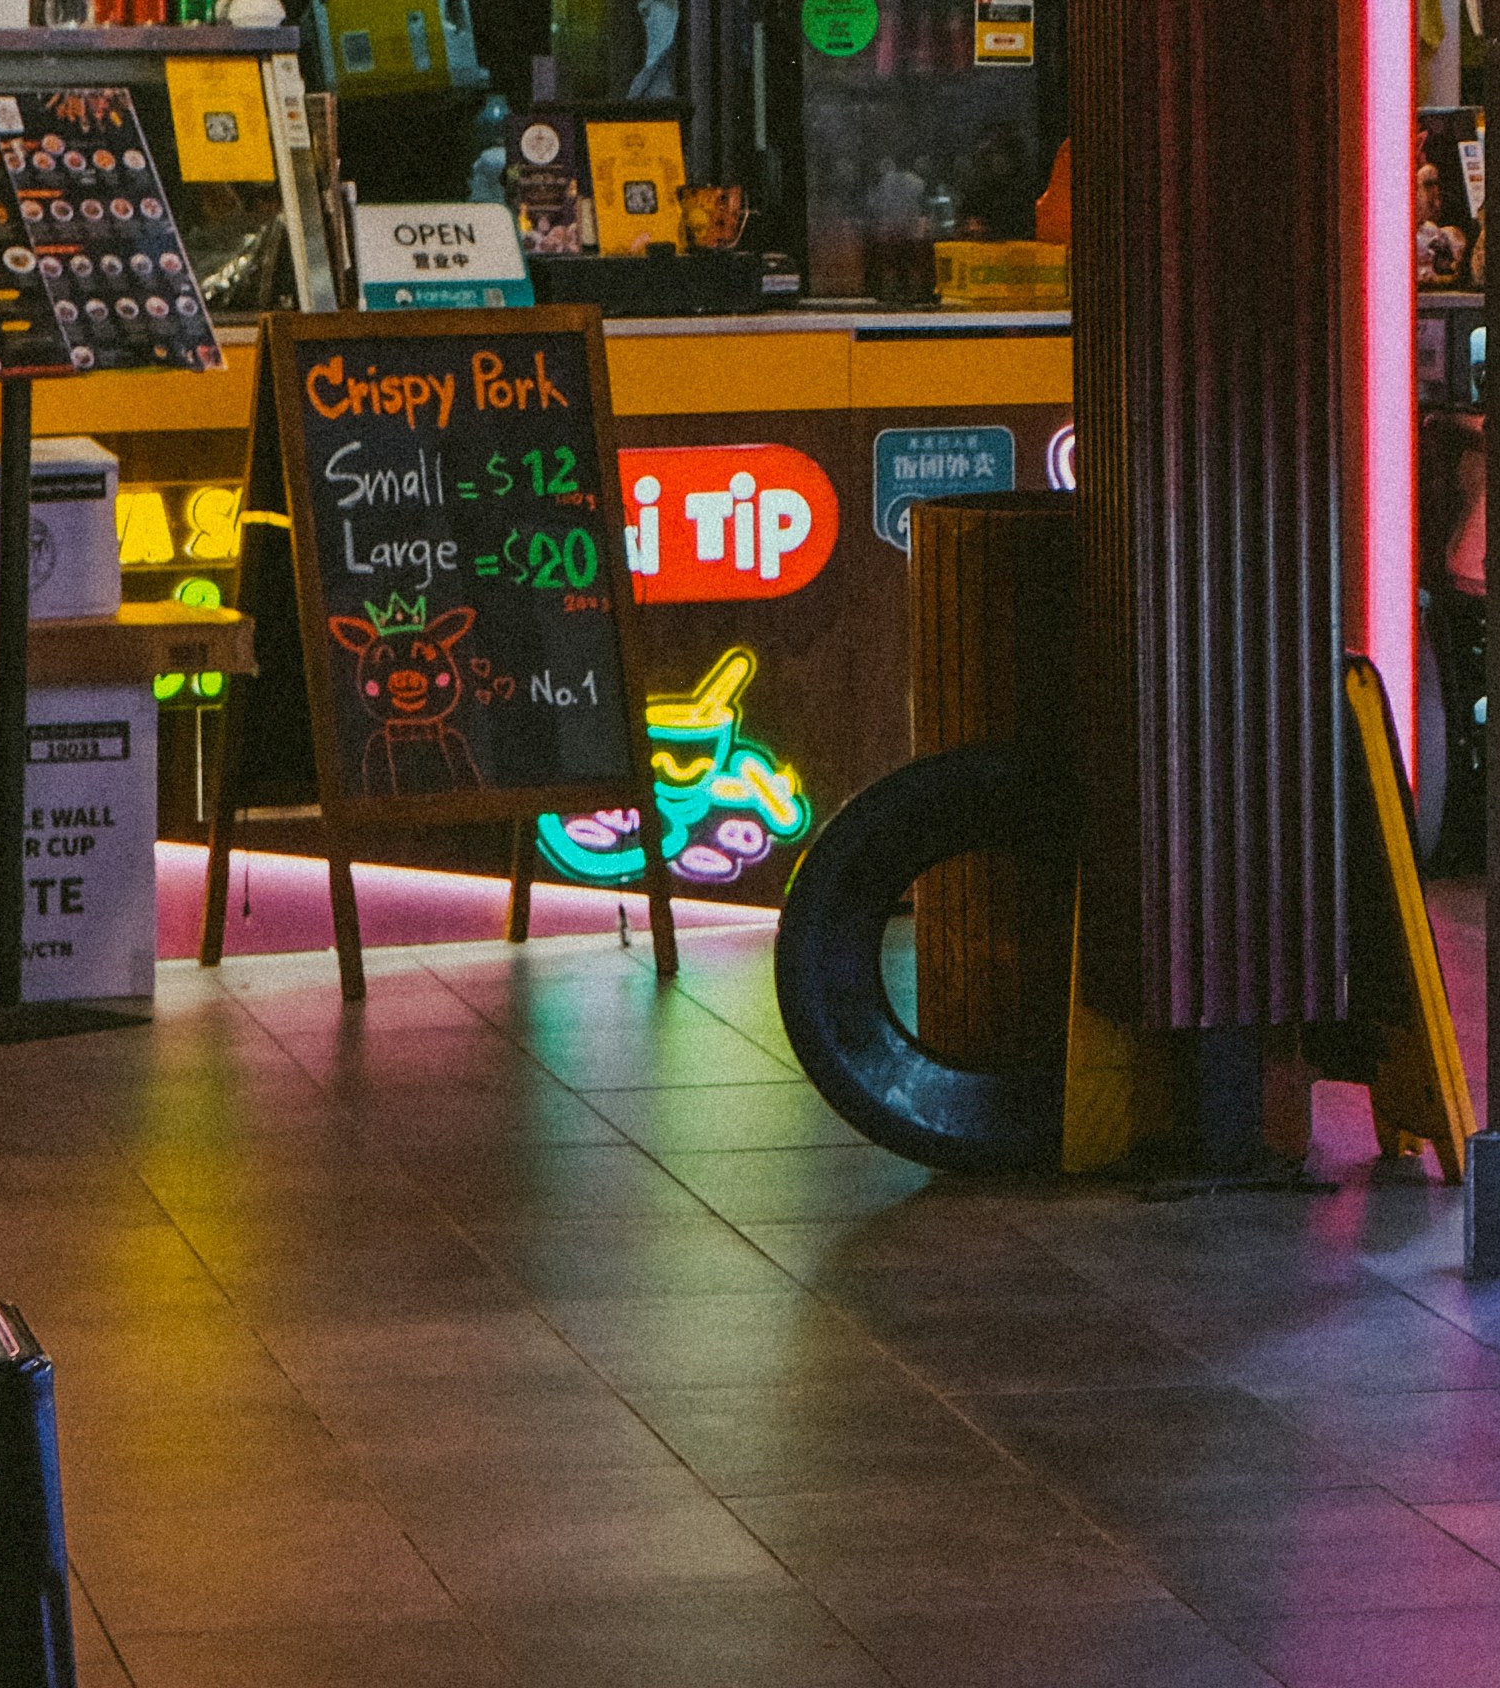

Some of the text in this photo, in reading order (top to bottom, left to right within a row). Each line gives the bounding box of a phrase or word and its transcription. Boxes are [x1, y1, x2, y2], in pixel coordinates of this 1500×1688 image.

[394, 223, 476, 246] OPEN
[306, 350, 569, 429] Crispy Pork
[325, 441, 445, 507] Small
[342, 520, 459, 590] Large
[50, 806, 116, 829] WALL
[47, 835, 96, 859] CUP
